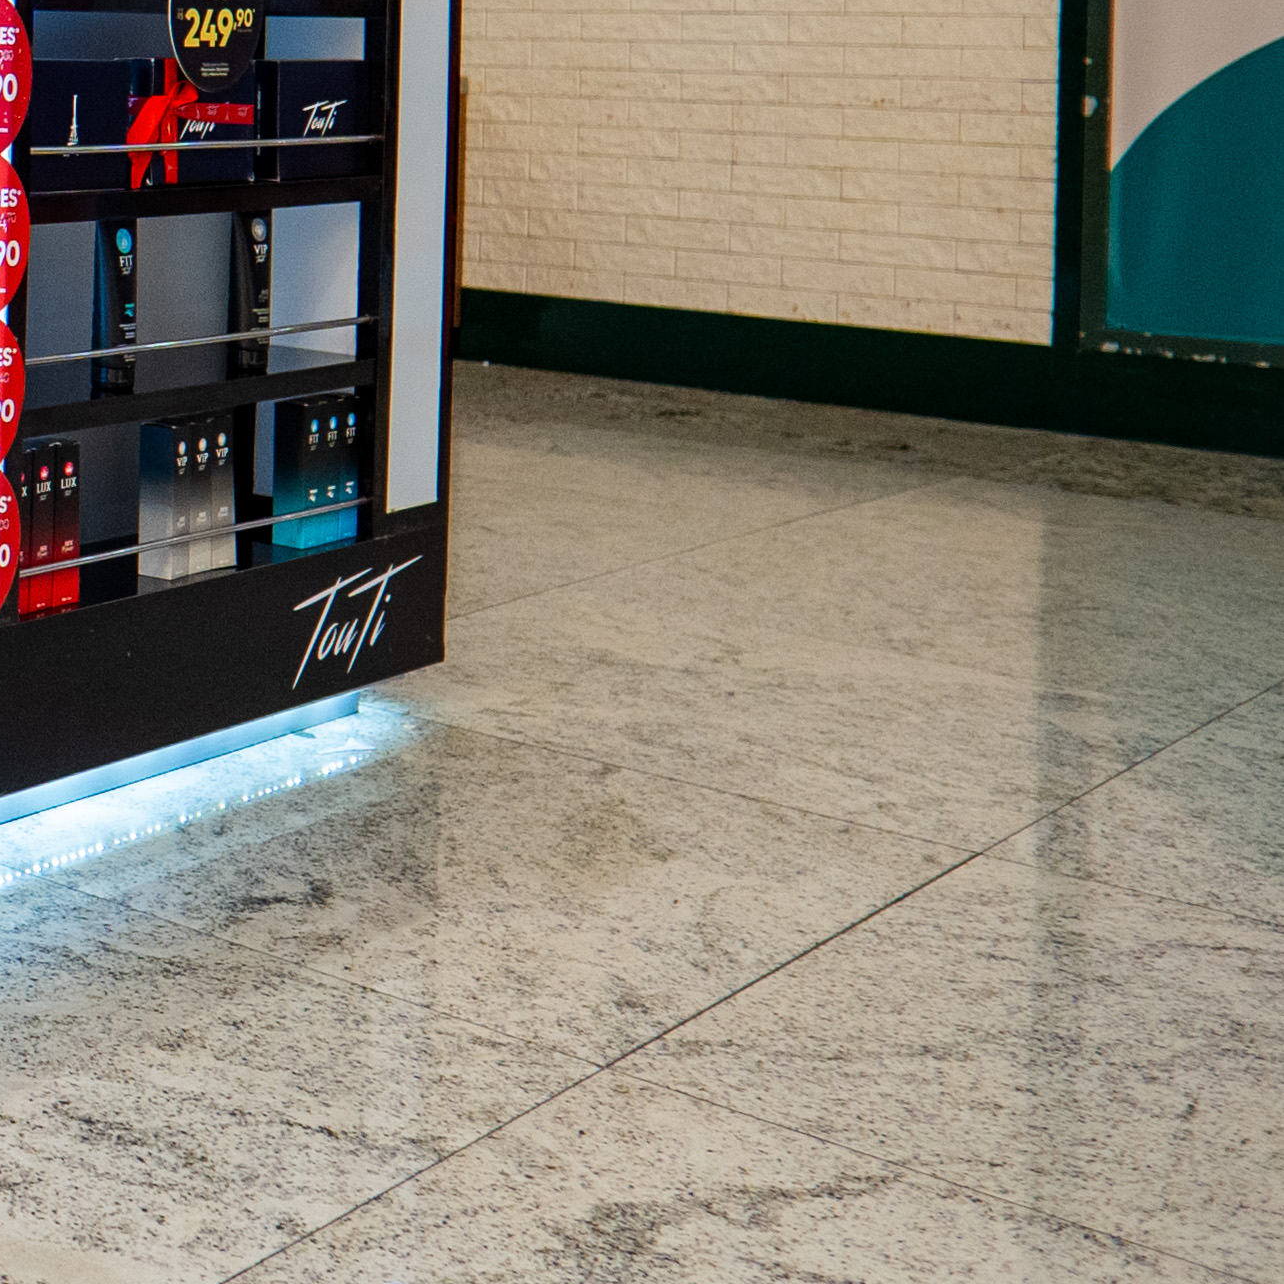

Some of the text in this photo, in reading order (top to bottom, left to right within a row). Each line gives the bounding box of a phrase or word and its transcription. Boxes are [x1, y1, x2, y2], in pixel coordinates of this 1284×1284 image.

[302, 100, 348, 137] TouTi
[36, 481, 51, 494] LUX
[61, 477, 77, 490] LUX
[293, 555, 423, 690] TouTi
